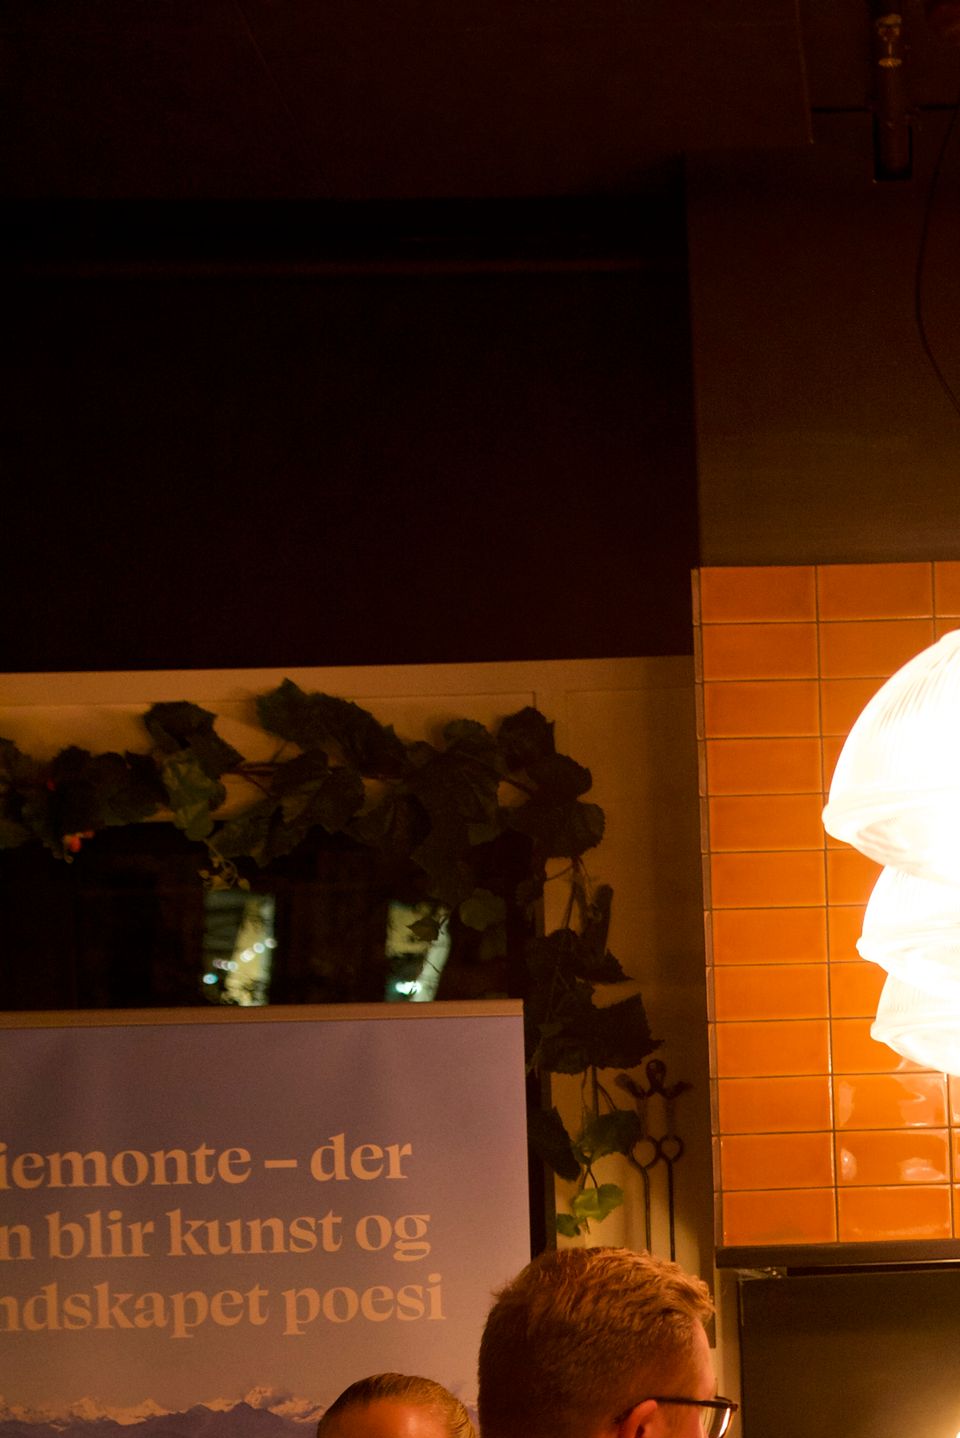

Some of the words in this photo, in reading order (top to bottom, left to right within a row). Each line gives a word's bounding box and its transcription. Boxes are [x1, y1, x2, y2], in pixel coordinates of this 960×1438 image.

[310, 1133, 412, 1181] der
[45, 1210, 154, 1258] blir
[166, 1208, 343, 1256] kunst
[355, 1213, 431, 1262] og
[281, 1273, 446, 1336] poesi
